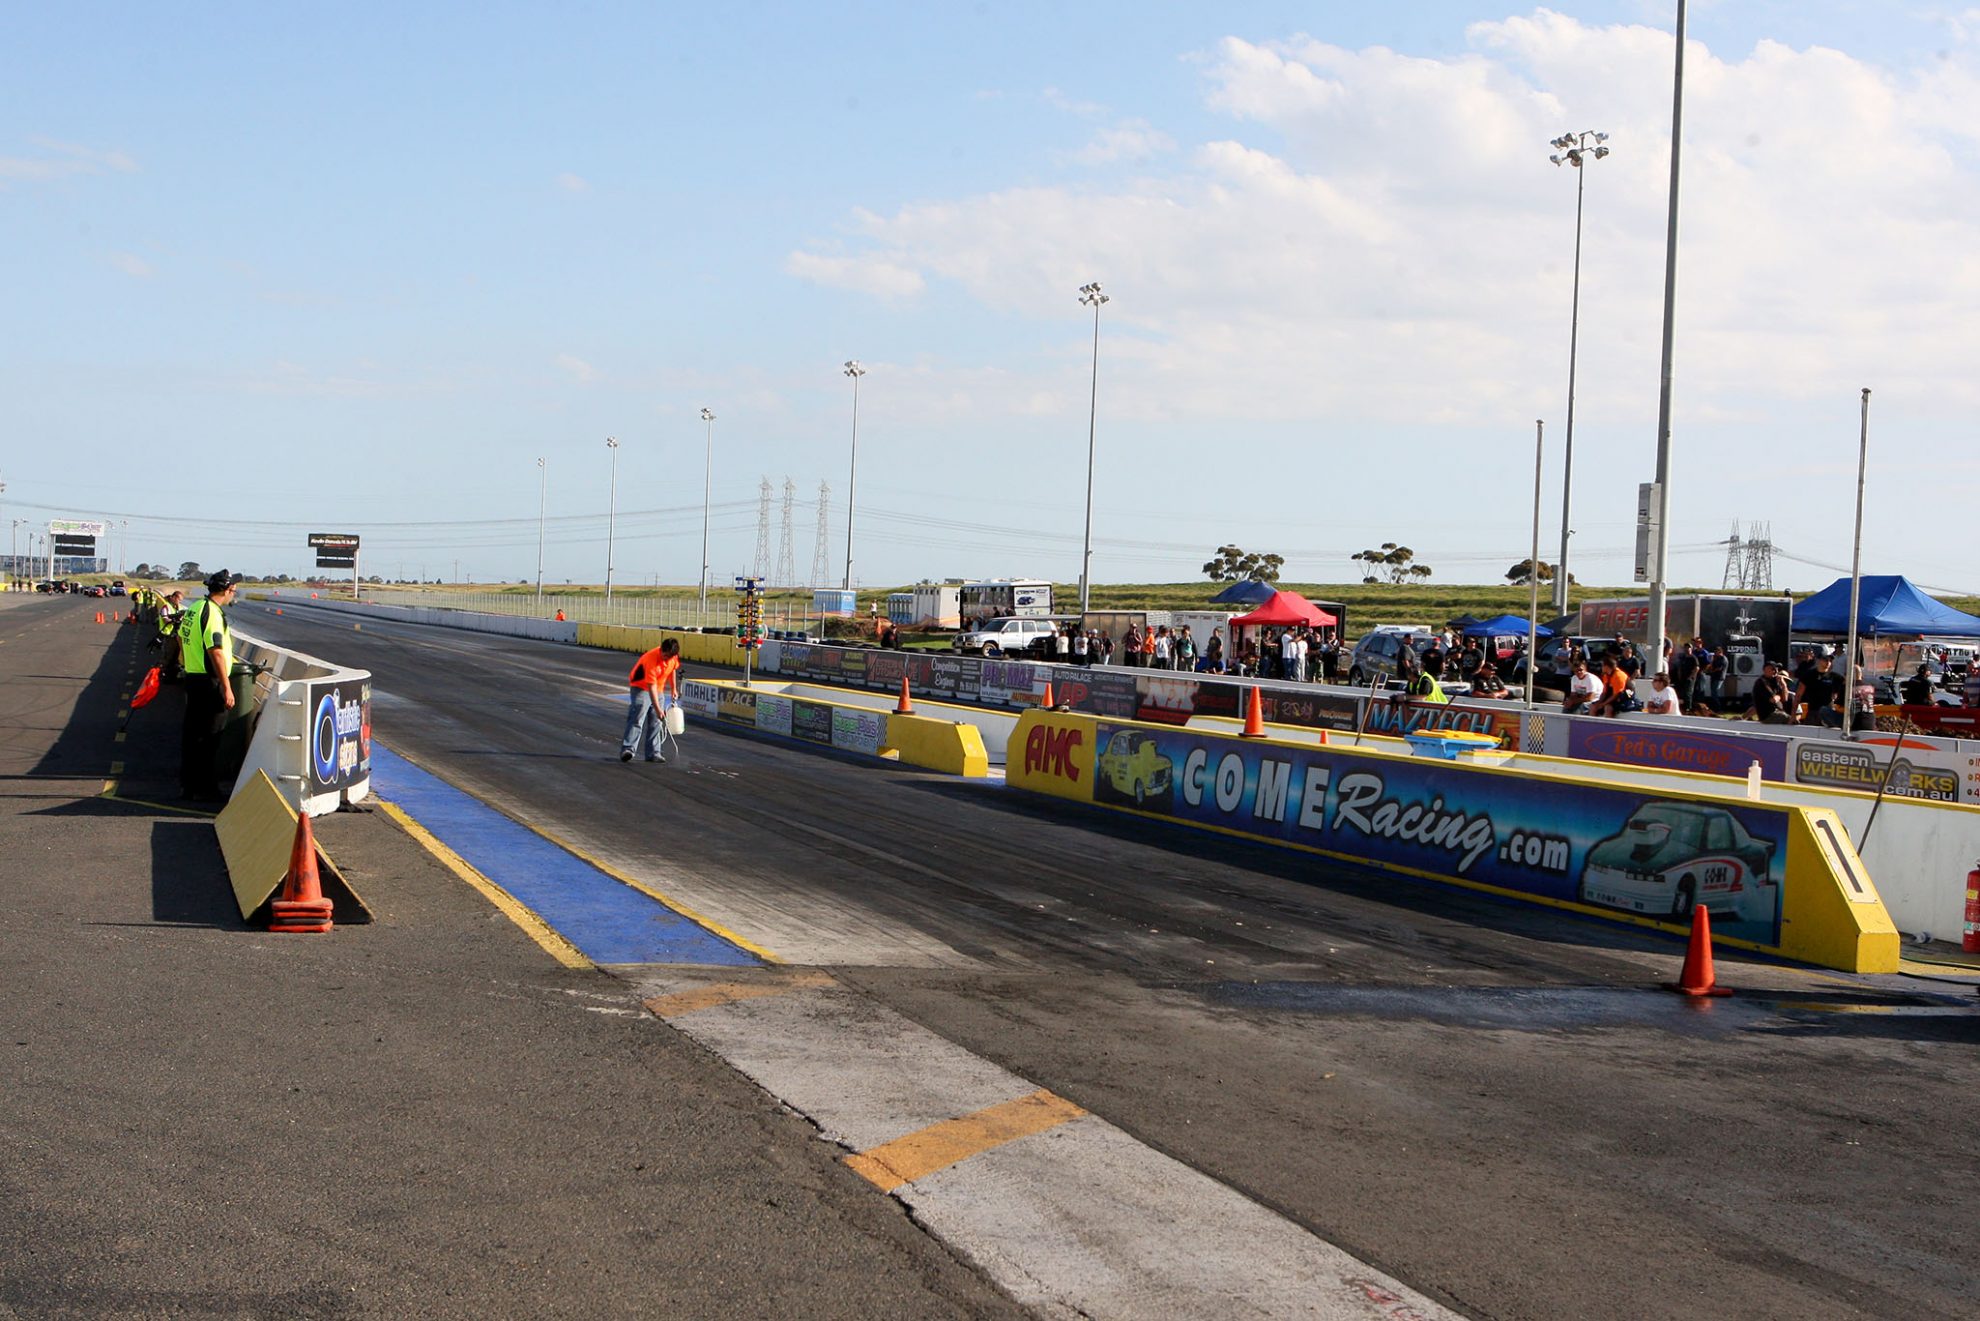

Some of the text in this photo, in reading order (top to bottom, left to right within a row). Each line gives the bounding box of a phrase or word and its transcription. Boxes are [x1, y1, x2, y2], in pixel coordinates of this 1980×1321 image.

[931, 657, 961, 674] Competition
[1054, 670, 1070, 680] AUTO
[1070, 671, 1093, 682] PALACE
[934, 673, 956, 688] Engines
[684, 683, 717, 704] MAHLE
[726, 690, 754, 707] RACE
[1369, 703, 1492, 734] MAZTECH
[1025, 724, 1083, 783] AMC
[1613, 735, 1731, 769] Ted's Garage
[1801, 750, 1869, 767] eastern
[1183, 749, 1330, 830] COME
[1333, 773, 1494, 873] Racing
[1815, 819, 1863, 893] 1
